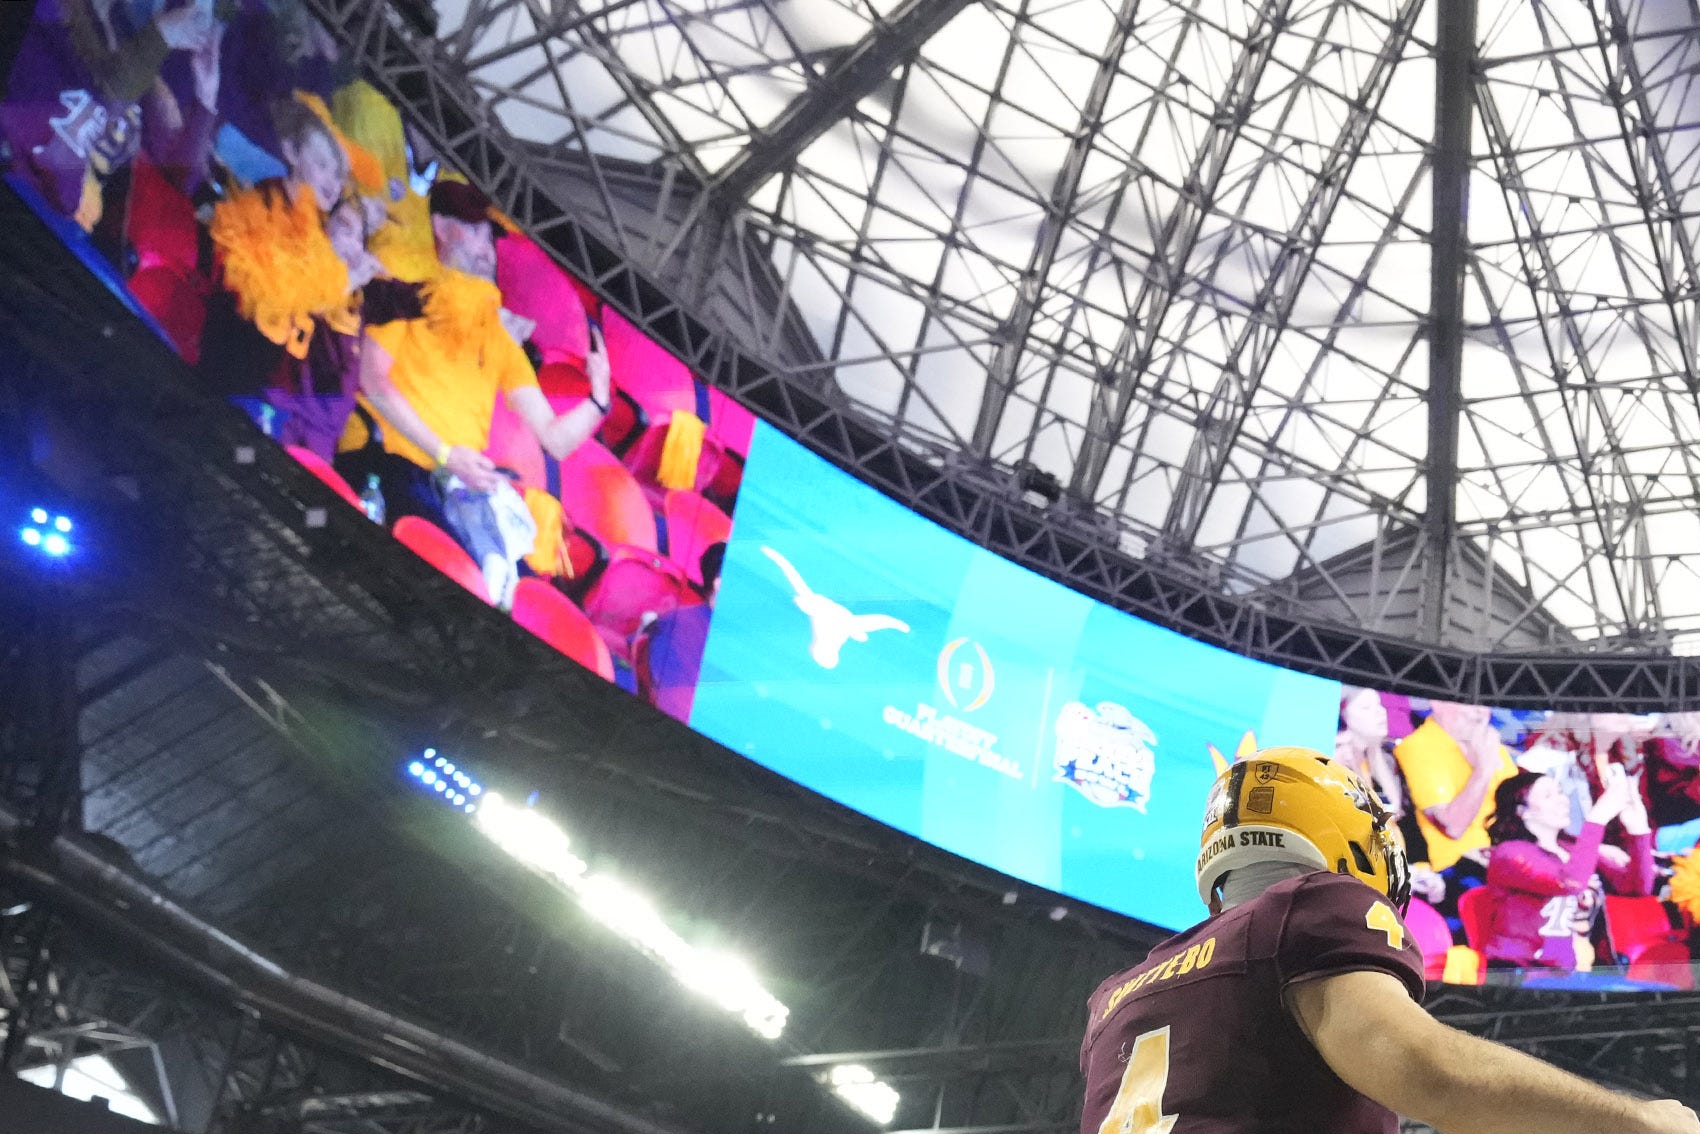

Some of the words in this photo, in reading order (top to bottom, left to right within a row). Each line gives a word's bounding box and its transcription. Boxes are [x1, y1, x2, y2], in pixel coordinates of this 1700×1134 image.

[1197, 834, 1235, 872] ARIZONA
[1240, 831, 1286, 848] STATE
[1365, 900, 1405, 951] 4
